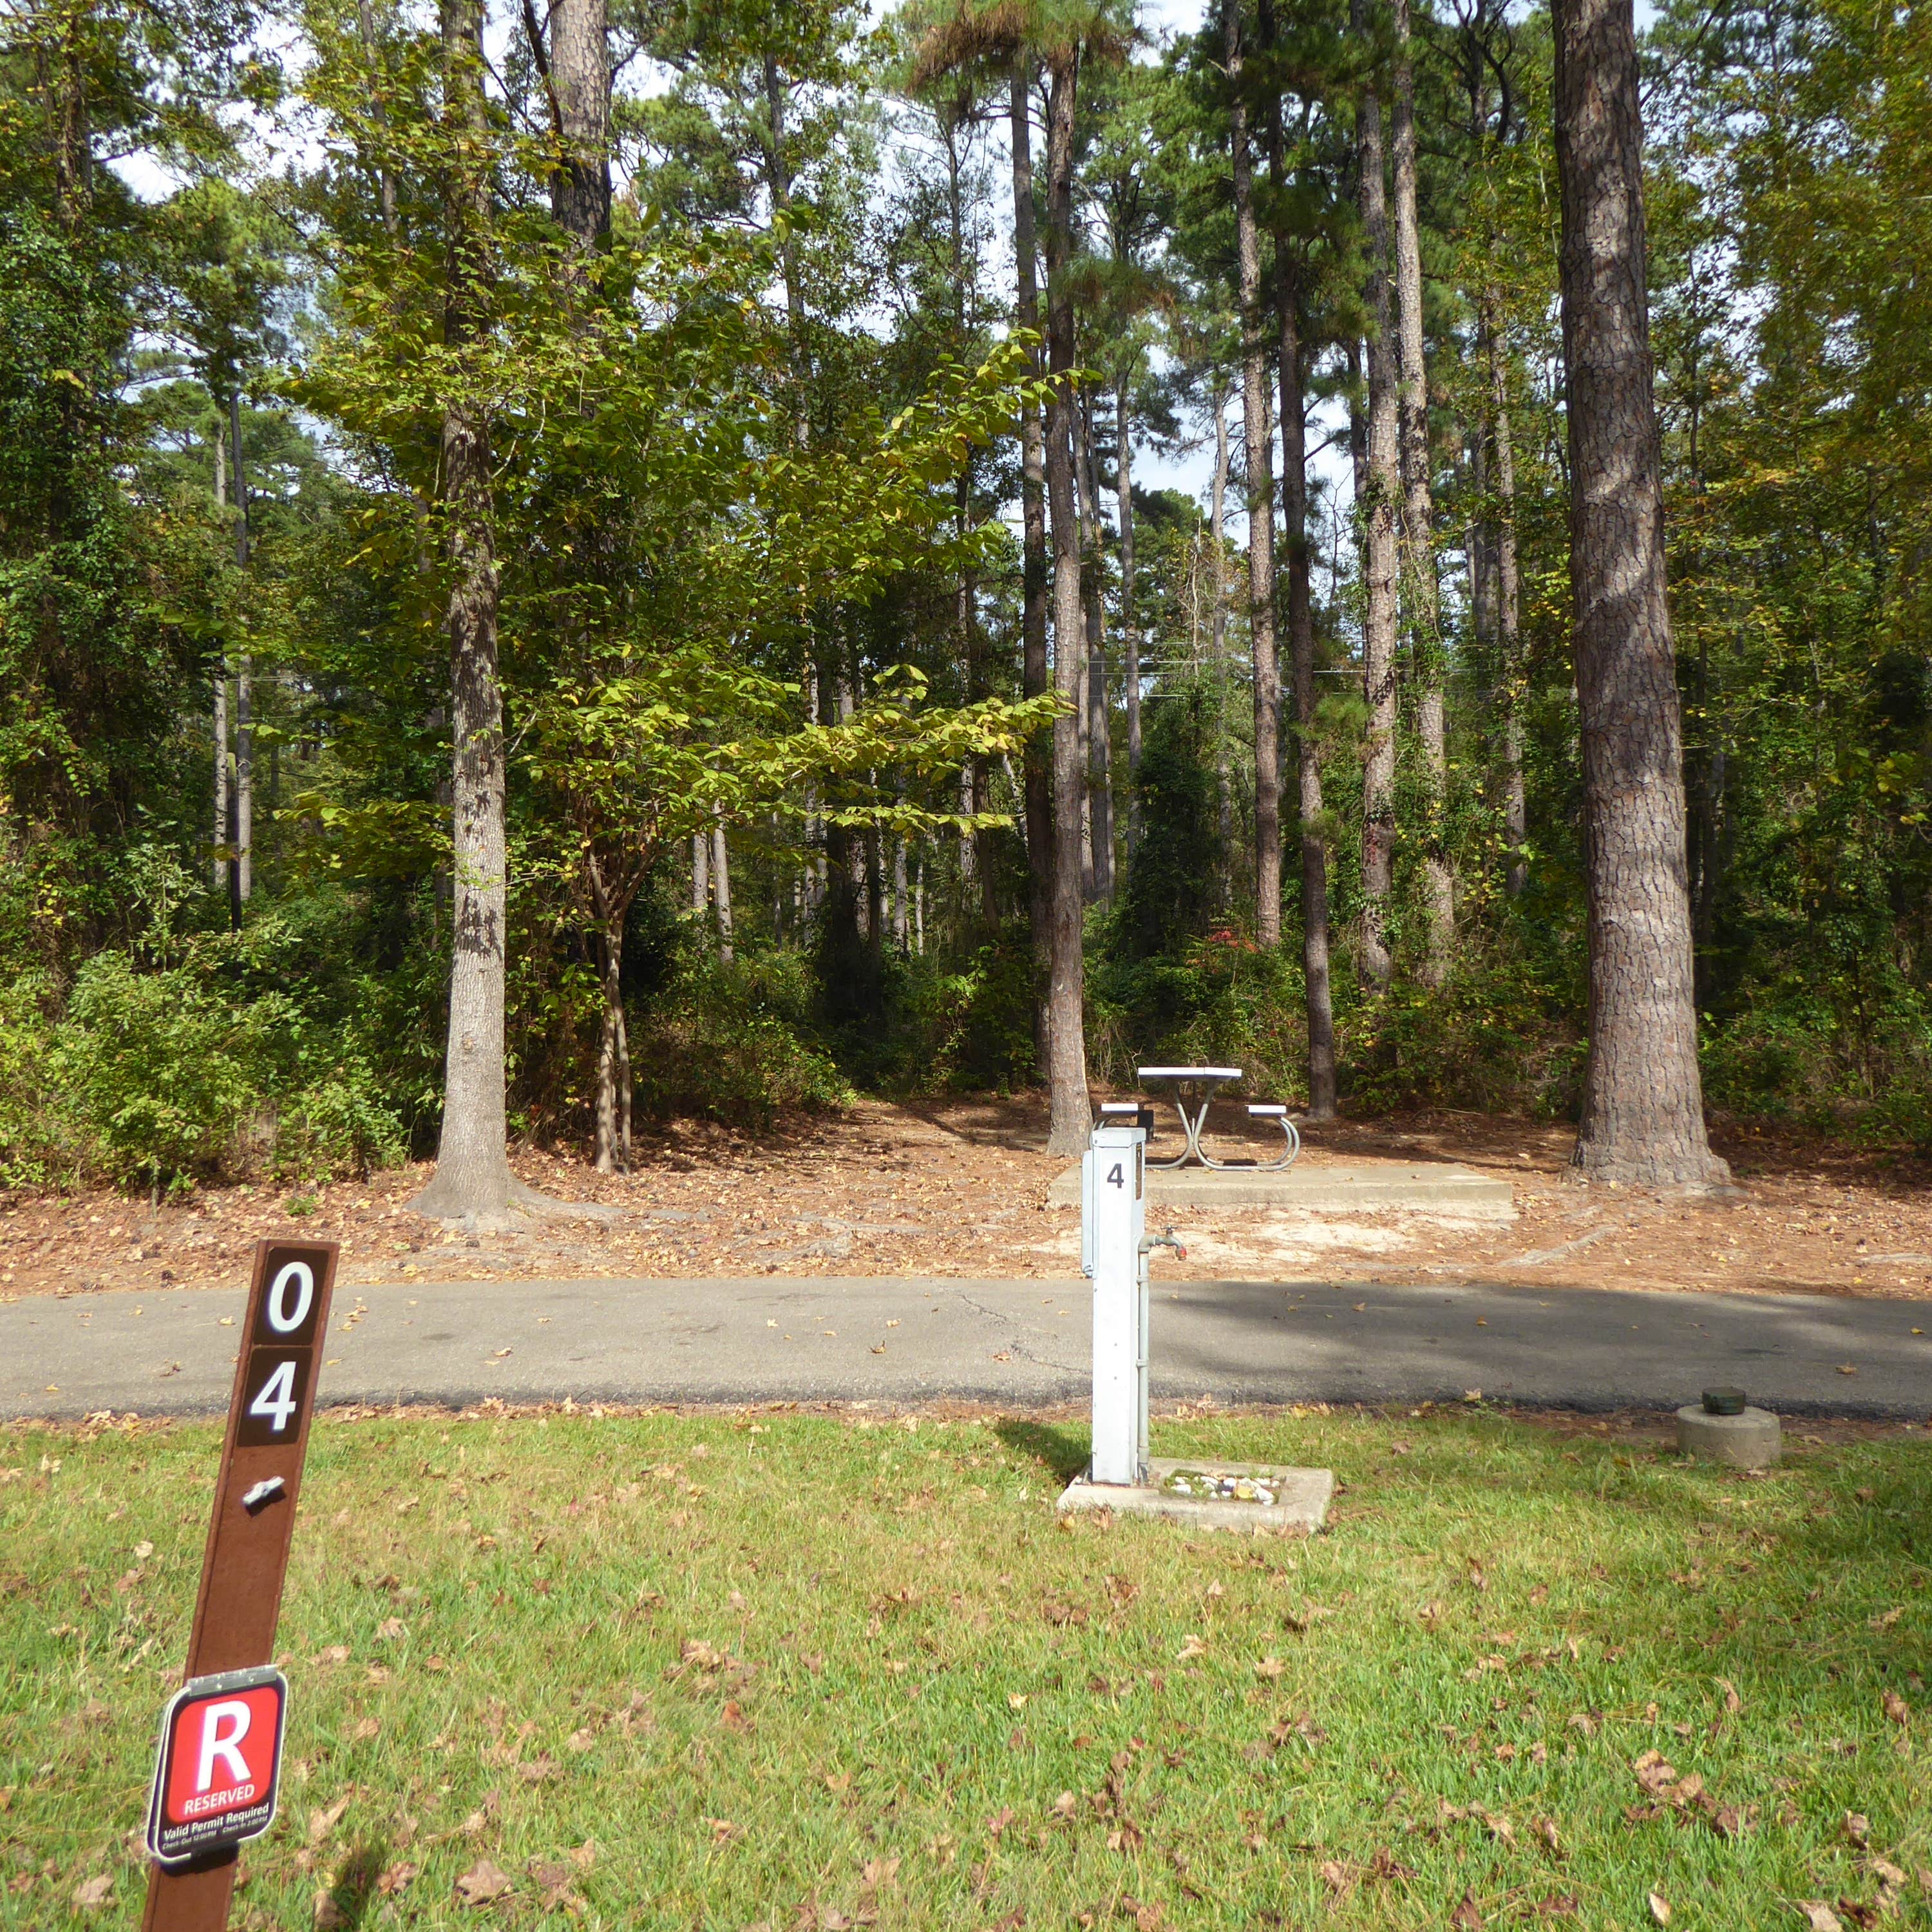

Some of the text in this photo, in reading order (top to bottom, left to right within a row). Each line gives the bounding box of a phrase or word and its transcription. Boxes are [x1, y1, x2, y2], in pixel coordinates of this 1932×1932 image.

[1107, 1163, 1124, 1189] 4
[269, 1261, 314, 1332] 0
[251, 1361, 297, 1431] 4
[196, 1700, 252, 1792] R
[164, 1802, 270, 1841] Valid Permit Required
[184, 1784, 254, 1815] RESERVED
